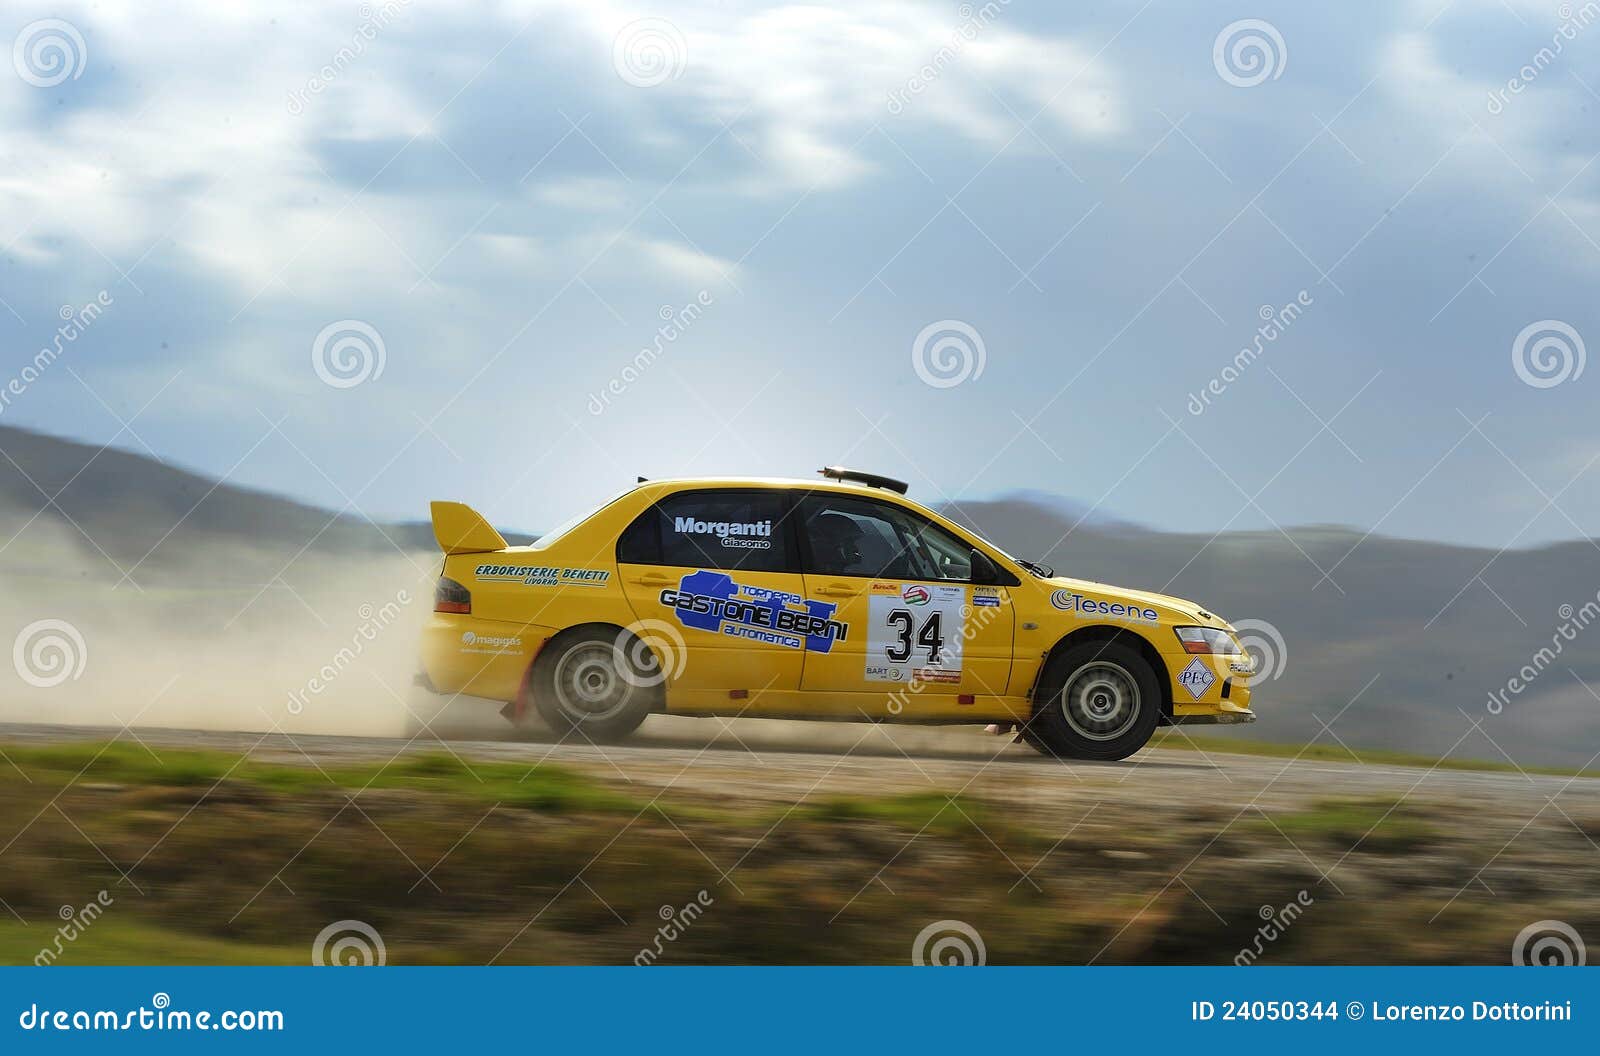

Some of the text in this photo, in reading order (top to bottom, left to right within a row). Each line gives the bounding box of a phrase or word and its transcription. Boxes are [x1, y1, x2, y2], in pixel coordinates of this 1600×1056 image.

[674, 516, 772, 538] Morganti
[721, 537, 771, 549] Giacomo
[475, 565, 610, 581] ERBORISTERIE BENETTI
[524, 577, 559, 586] LIVORNO
[1071, 594, 1158, 621] Tesene
[476, 635, 521, 648] magigas
[885, 608, 945, 666] 34
[866, 667, 888, 675] BART
